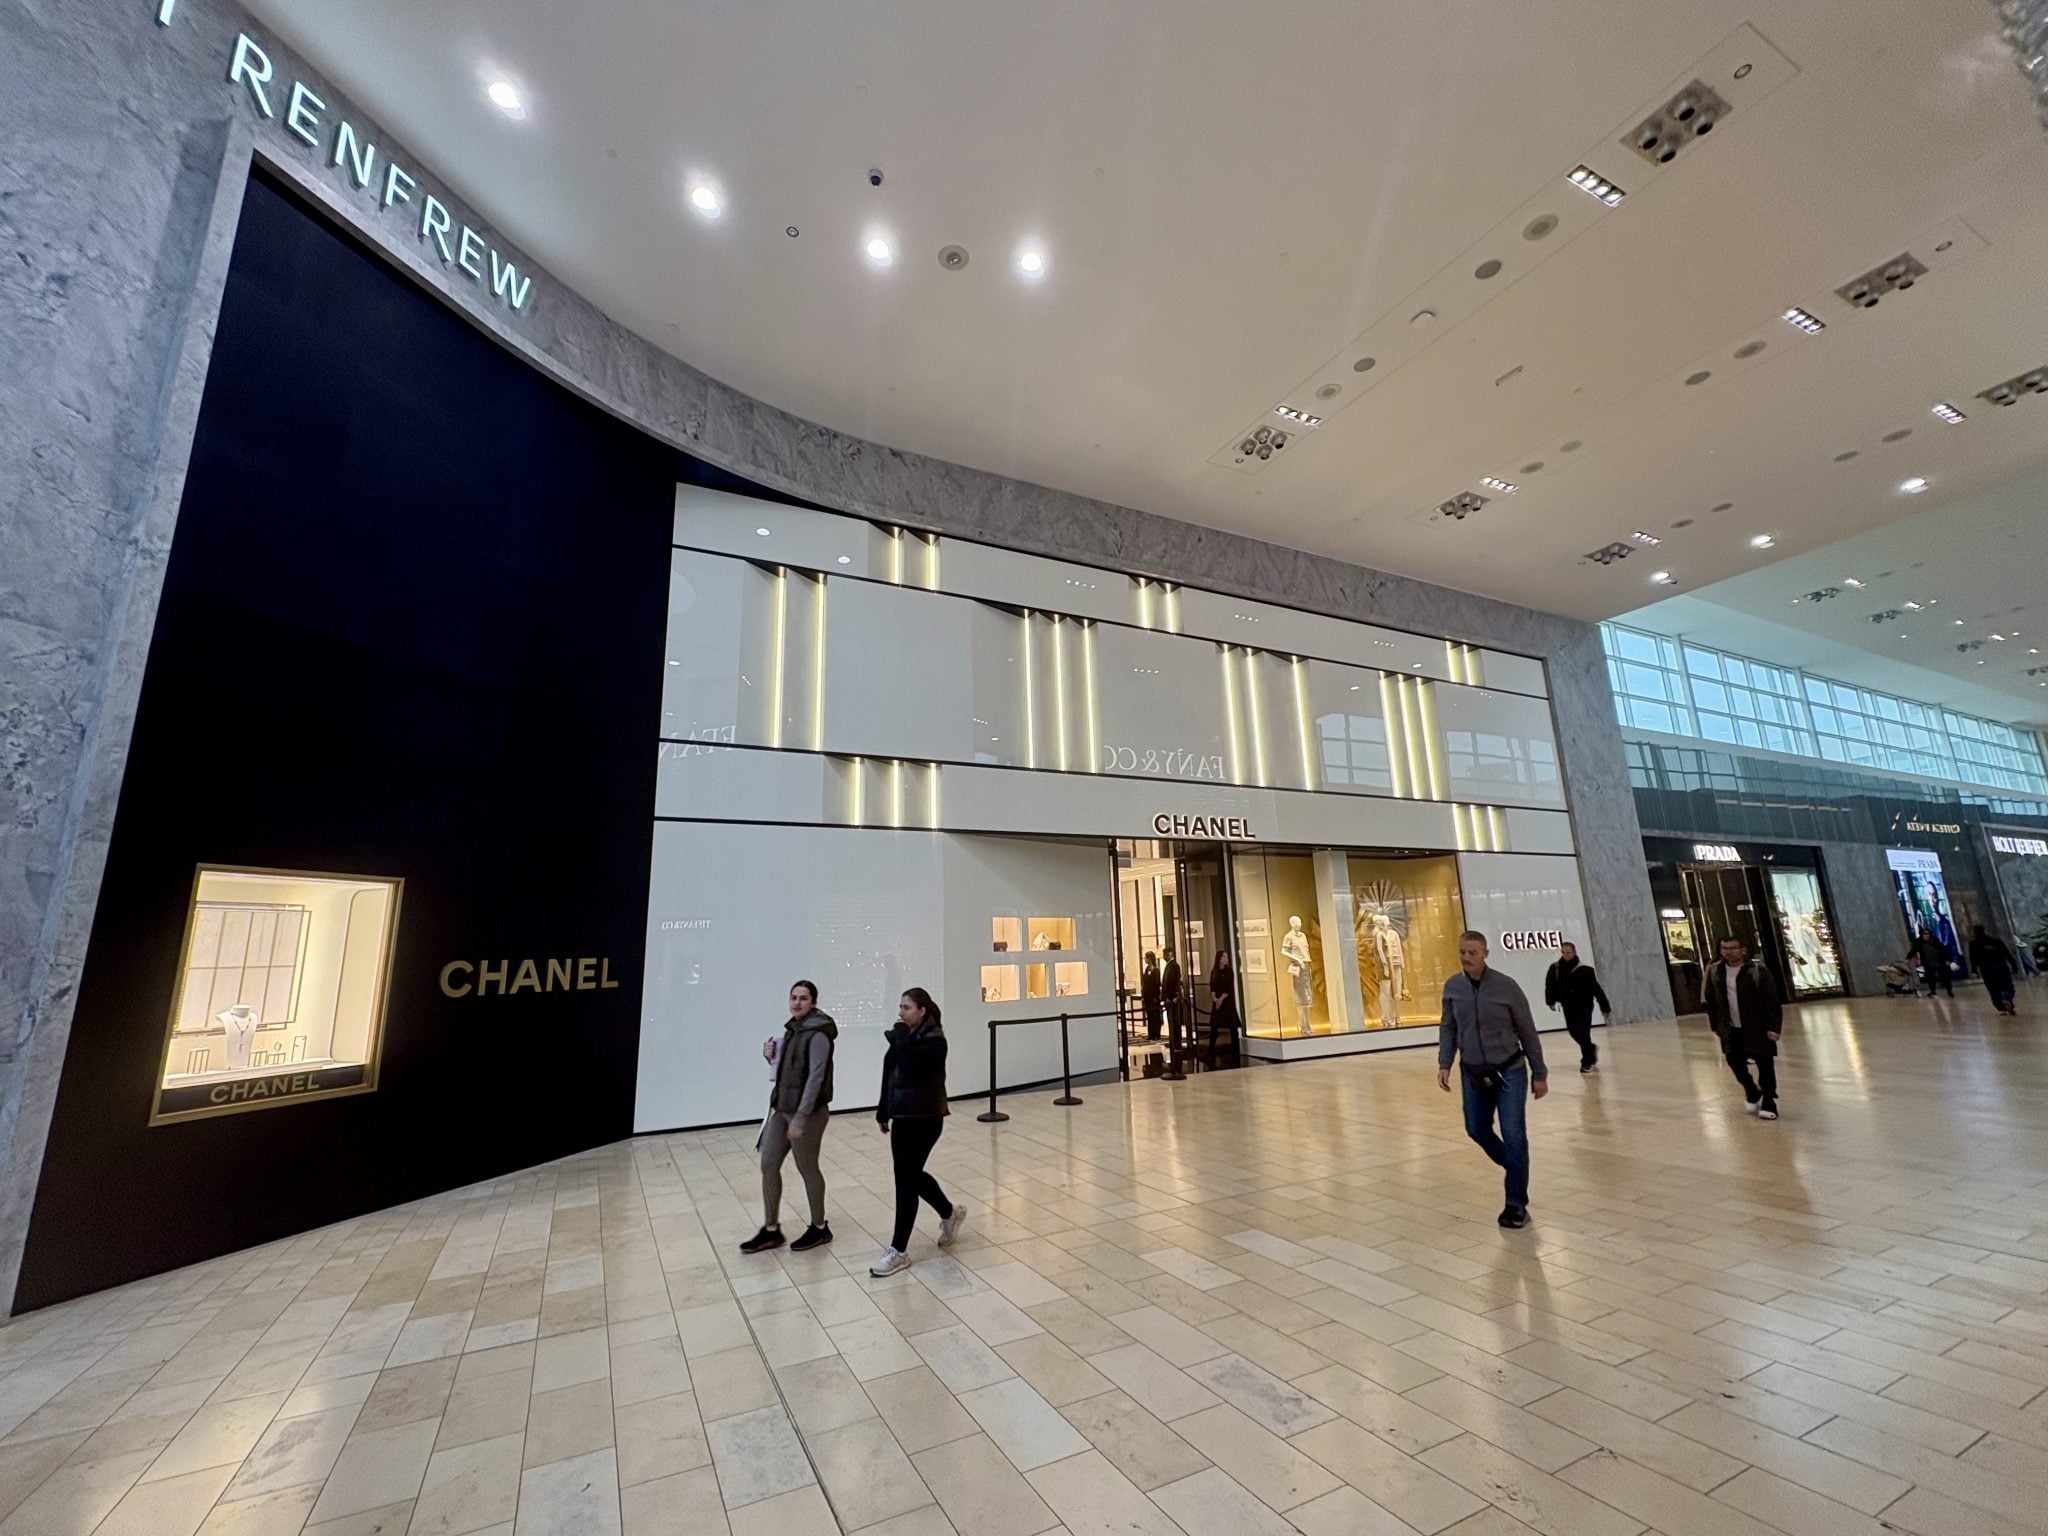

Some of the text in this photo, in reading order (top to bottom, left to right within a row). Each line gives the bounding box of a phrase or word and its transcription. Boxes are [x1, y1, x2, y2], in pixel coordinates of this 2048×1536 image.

[230, 32, 531, 310] RENFREW
[1153, 813, 1256, 839] CHANEL
[1694, 845, 1742, 861] PRADA
[1991, 836, 2015, 853] HOLT
[1917, 859, 1939, 869] PRADA
[439, 957, 619, 998] CHANEL
[210, 1072, 320, 1104] CHANEL
